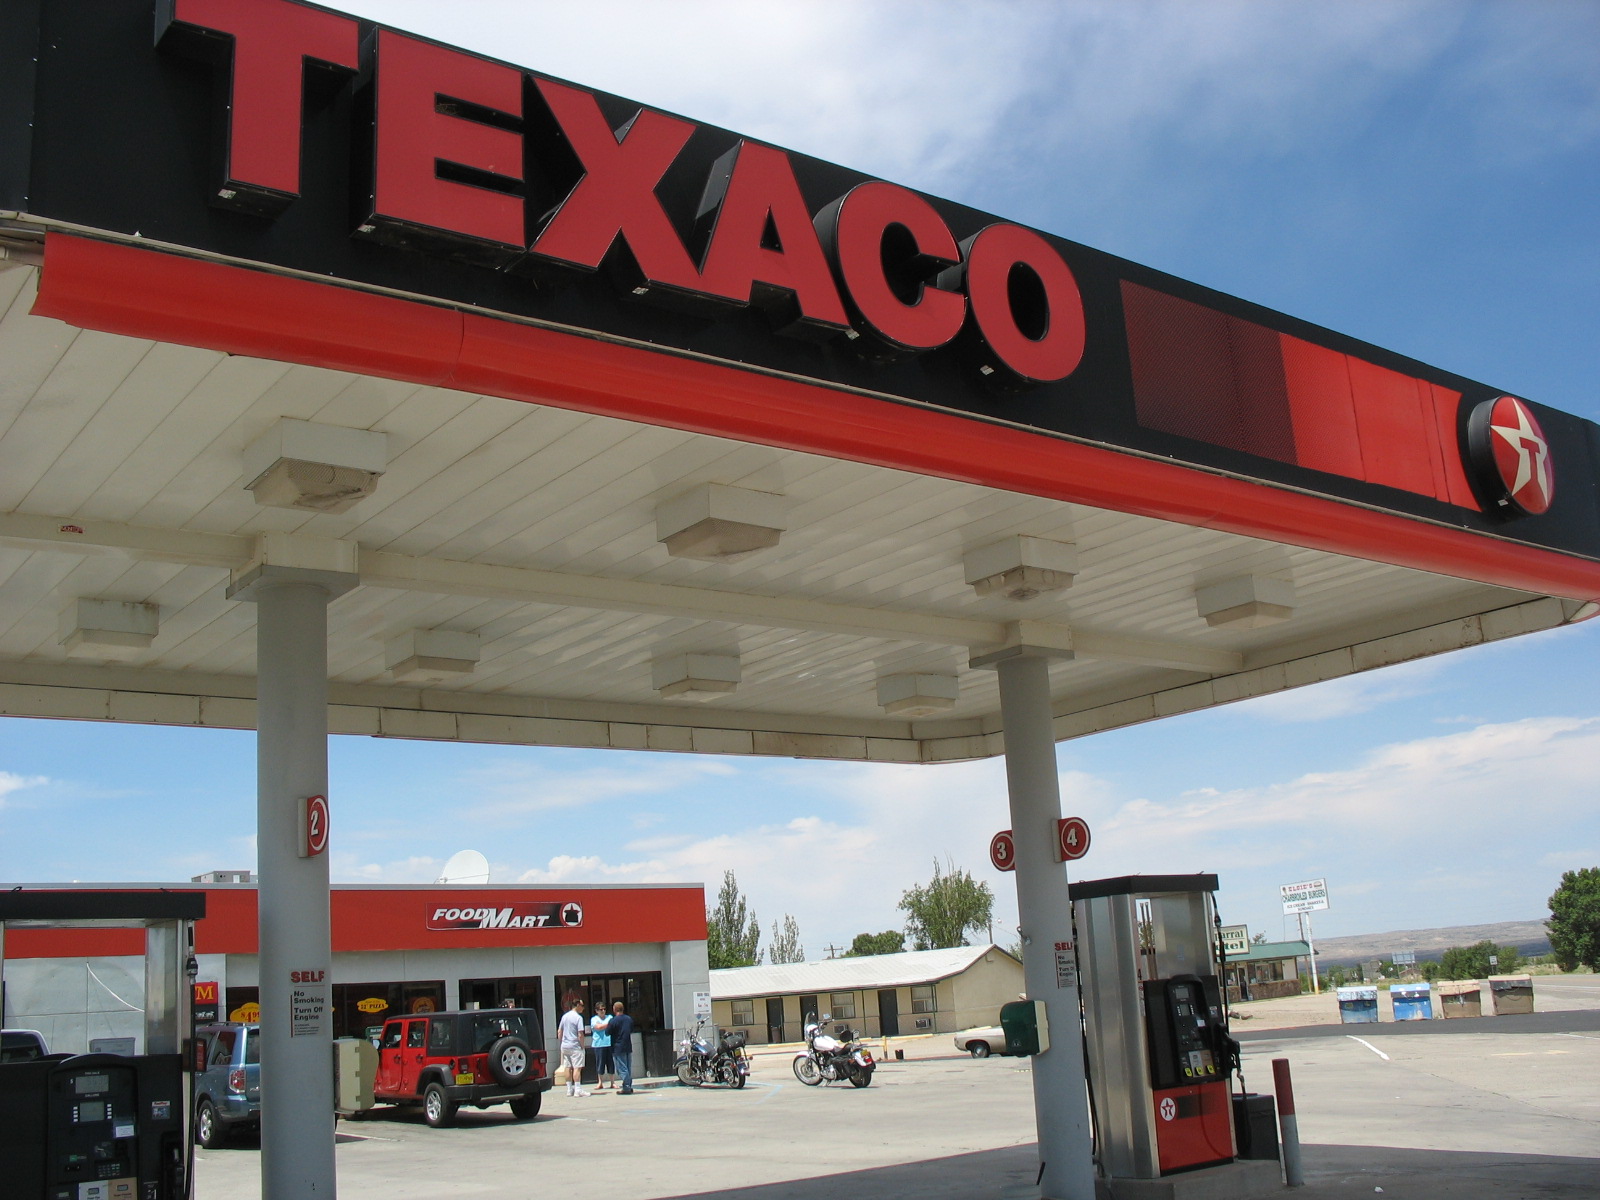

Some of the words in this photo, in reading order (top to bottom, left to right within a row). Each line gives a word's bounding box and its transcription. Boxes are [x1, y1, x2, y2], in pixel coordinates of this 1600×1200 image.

[172, 0, 1086, 383] TEXACO
[310, 810, 319, 836] 2
[1066, 827, 1078, 847] 4
[996, 841, 1007, 860] 3
[290, 970, 325, 983] SELF
